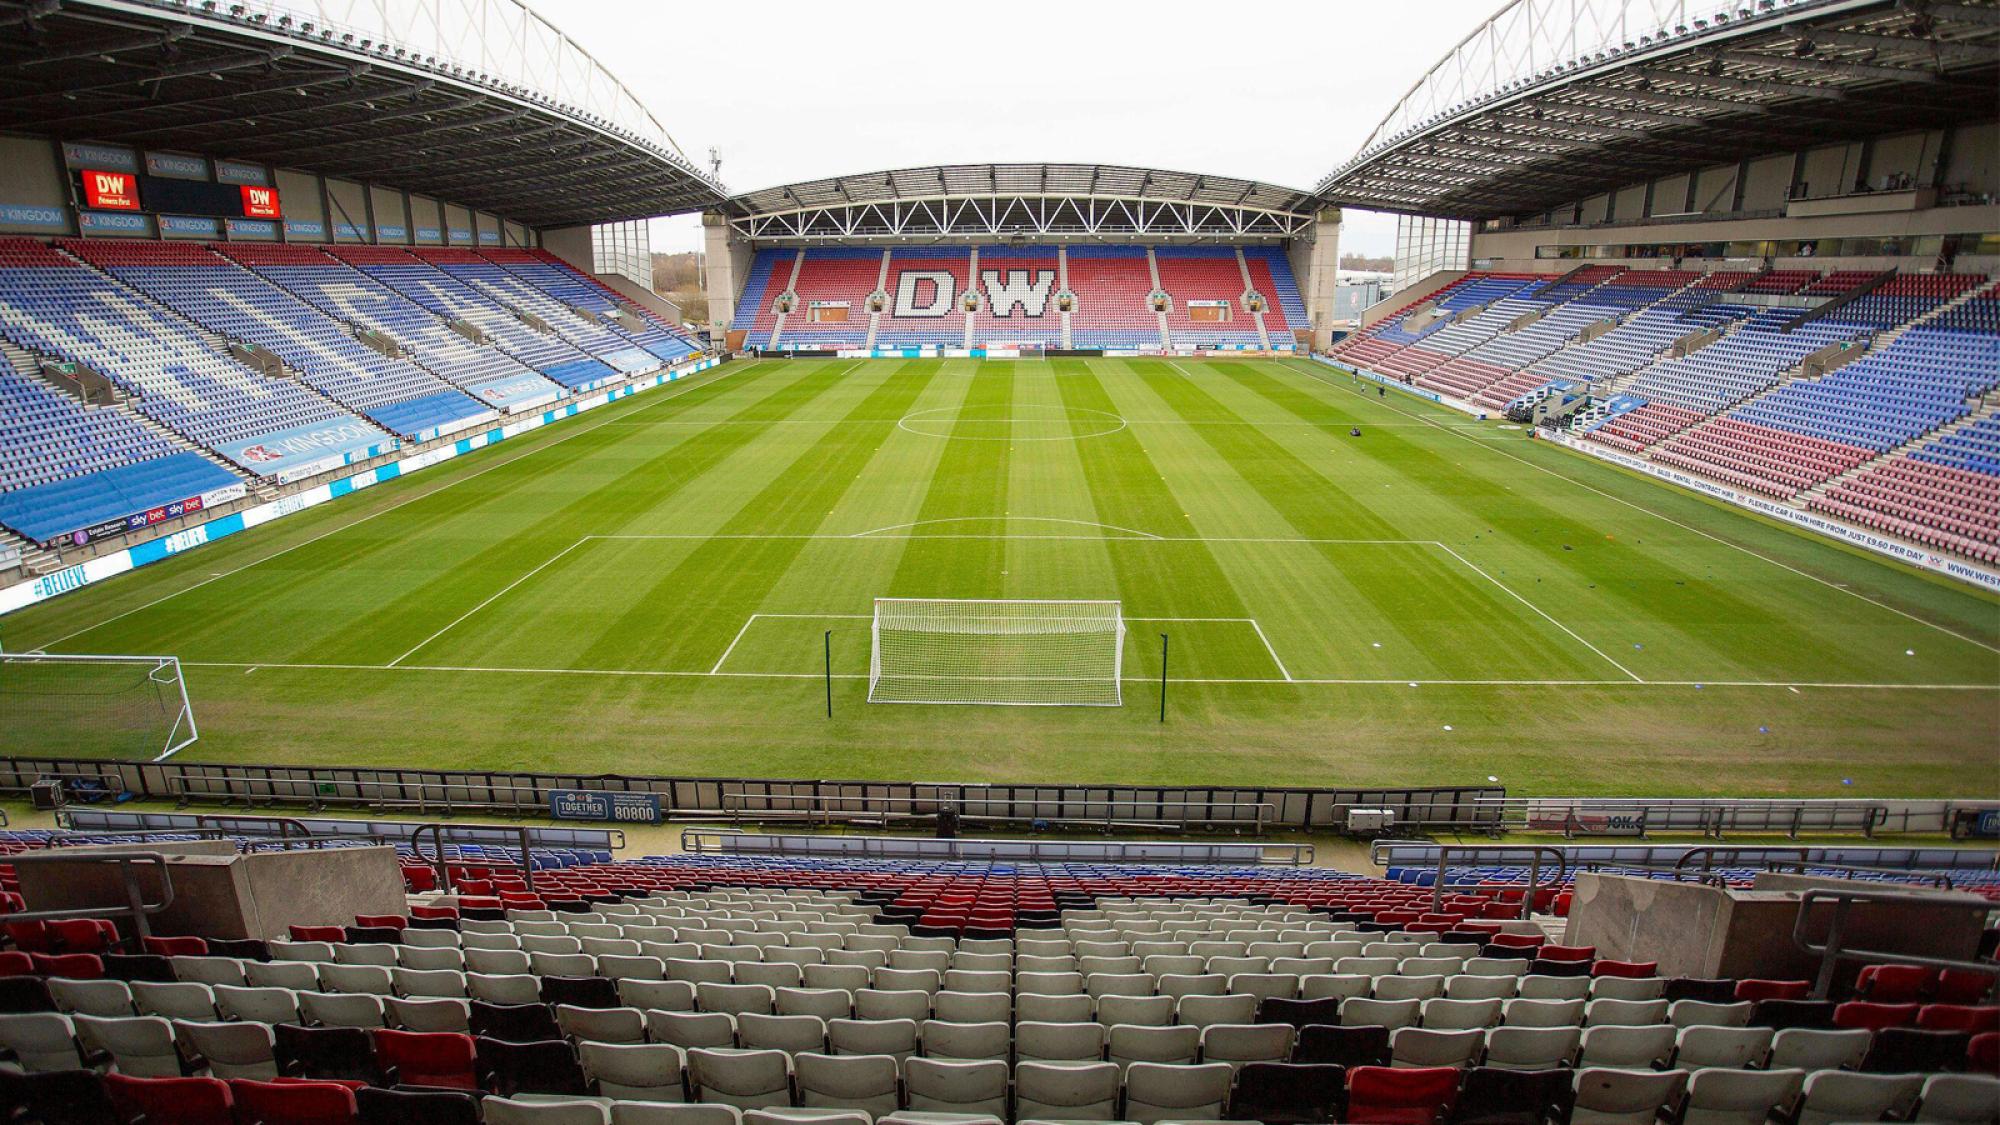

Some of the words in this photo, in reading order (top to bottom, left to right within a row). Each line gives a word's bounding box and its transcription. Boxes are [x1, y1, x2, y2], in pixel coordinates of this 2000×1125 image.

[95, 174, 124, 195] DW
[249, 189, 270, 206] DW
[8, 208, 63, 222] KINGDOM
[99, 215, 145, 228] KINGDOM
[894, 269, 1057, 319] DW
[281, 421, 378, 453] KINGDOM
[168, 505, 184, 515] sky
[185, 498, 201, 511] bet
[131, 515, 147, 527] sky
[149, 509, 165, 522] bet
[1748, 498, 1774, 512] FLEXIBLE
[1774, 505, 1789, 516] CAR
[1794, 512, 1809, 523] VAN
[1809, 517, 1825, 528] HIRE
[1825, 523, 1847, 535] FROM
[1847, 530, 1866, 542] JUST
[1889, 544, 1906, 555] PER
[1906, 549, 1925, 561] DAY
[33, 564, 89, 596] #BELIEVE
[560, 802, 604, 812] TOGETHER
[614, 806, 655, 820] 80800
